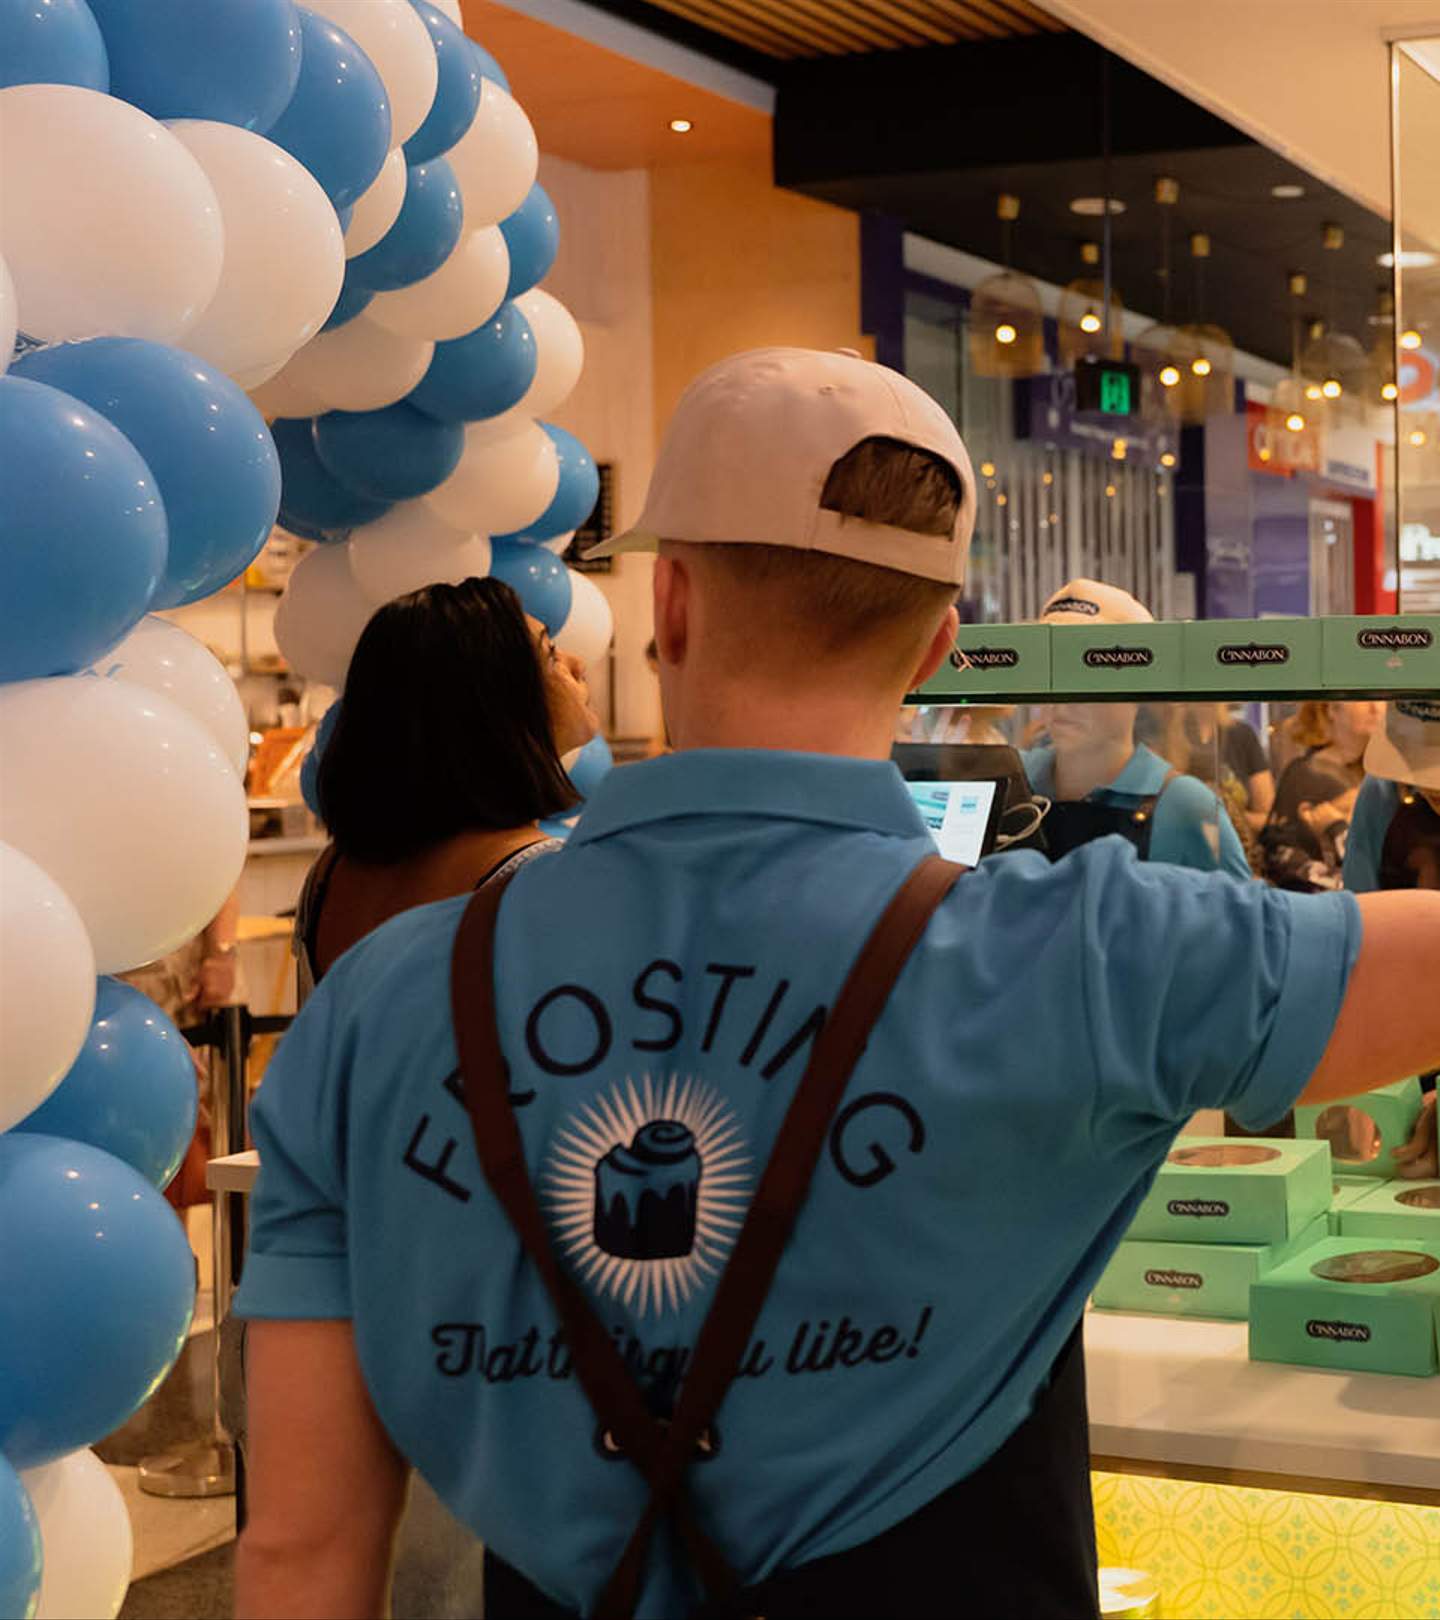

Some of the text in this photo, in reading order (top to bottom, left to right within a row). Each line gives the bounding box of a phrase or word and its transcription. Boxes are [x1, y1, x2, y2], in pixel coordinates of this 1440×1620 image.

[1360, 632, 1429, 645] CINNABON
[1086, 651, 1149, 664] CINNABON
[1220, 649, 1285, 662] CINNABON
[1169, 1202, 1226, 1215] CINNABON
[1147, 1273, 1200, 1286] CINNABON
[1308, 1320, 1368, 1339] CINNABON
[785, 1305, 934, 1376] like!
